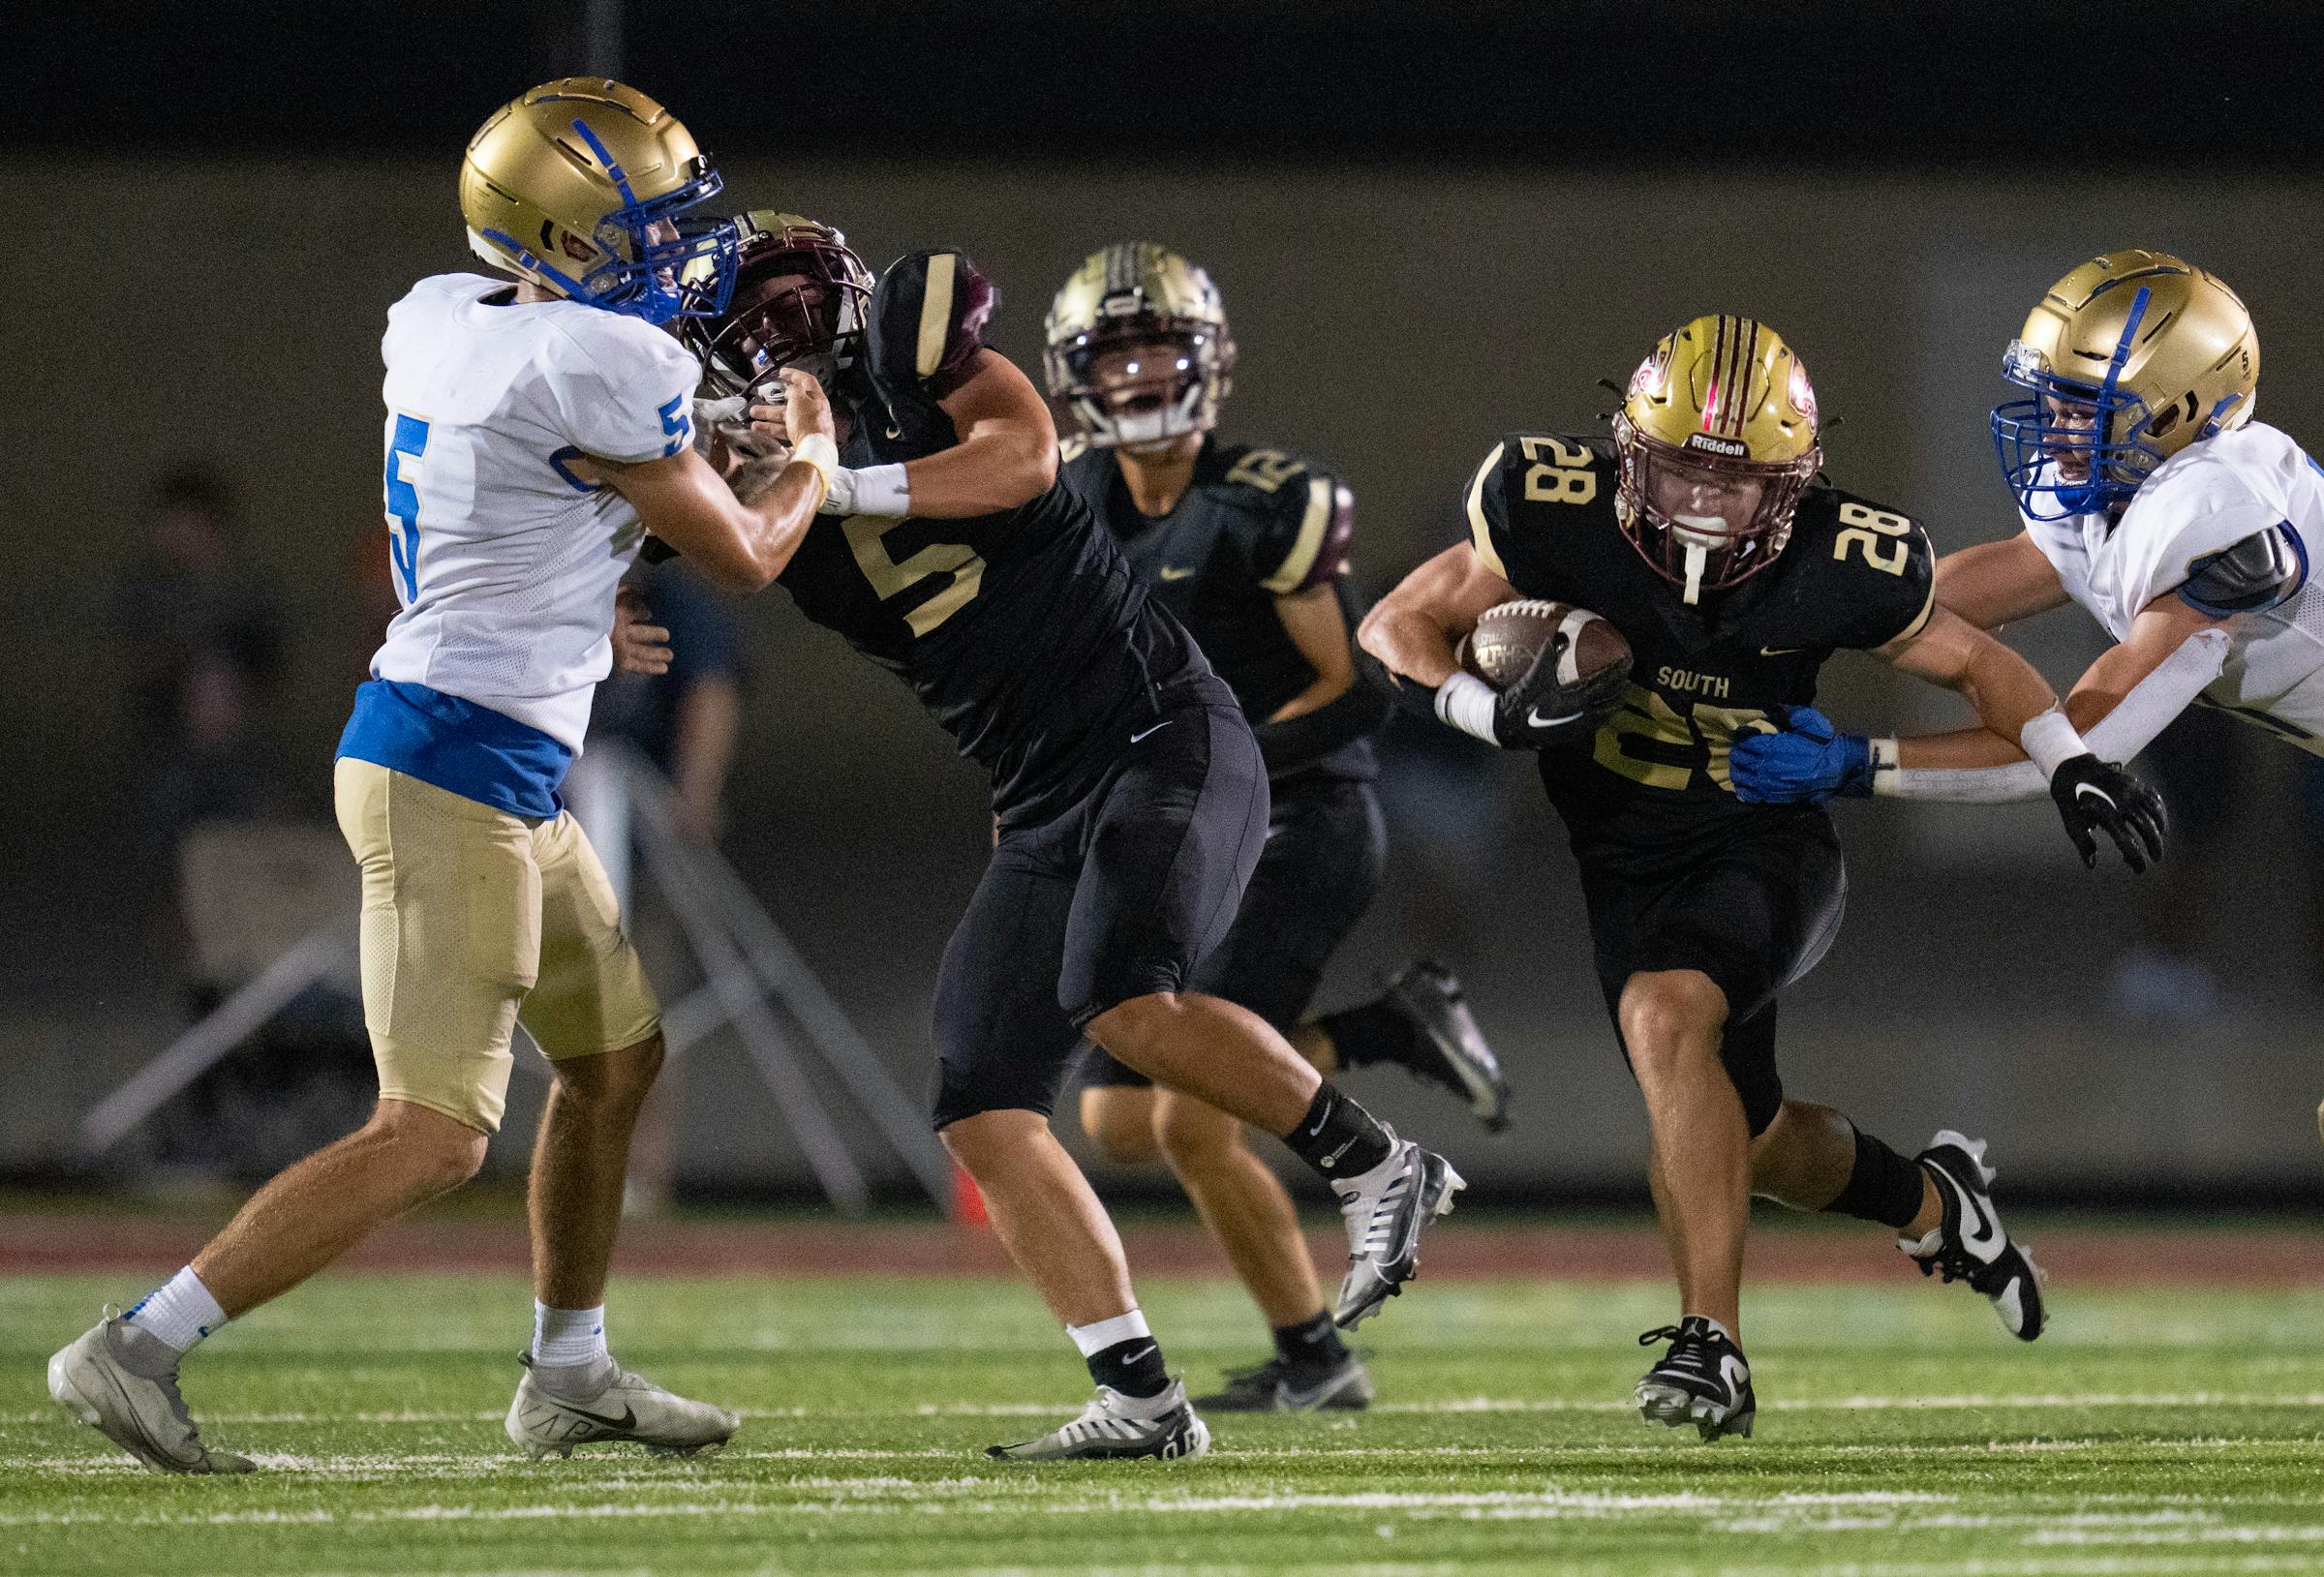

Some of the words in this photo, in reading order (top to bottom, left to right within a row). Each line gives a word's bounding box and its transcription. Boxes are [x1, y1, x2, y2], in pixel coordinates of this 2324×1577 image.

[655, 390, 694, 459] 5
[1692, 435, 1745, 456] Riddell
[1519, 436, 1597, 505] 28
[385, 408, 433, 605] 5
[1833, 502, 1911, 577] 28
[841, 513, 988, 639] 5
[1657, 666, 1729, 699] SOUTH
